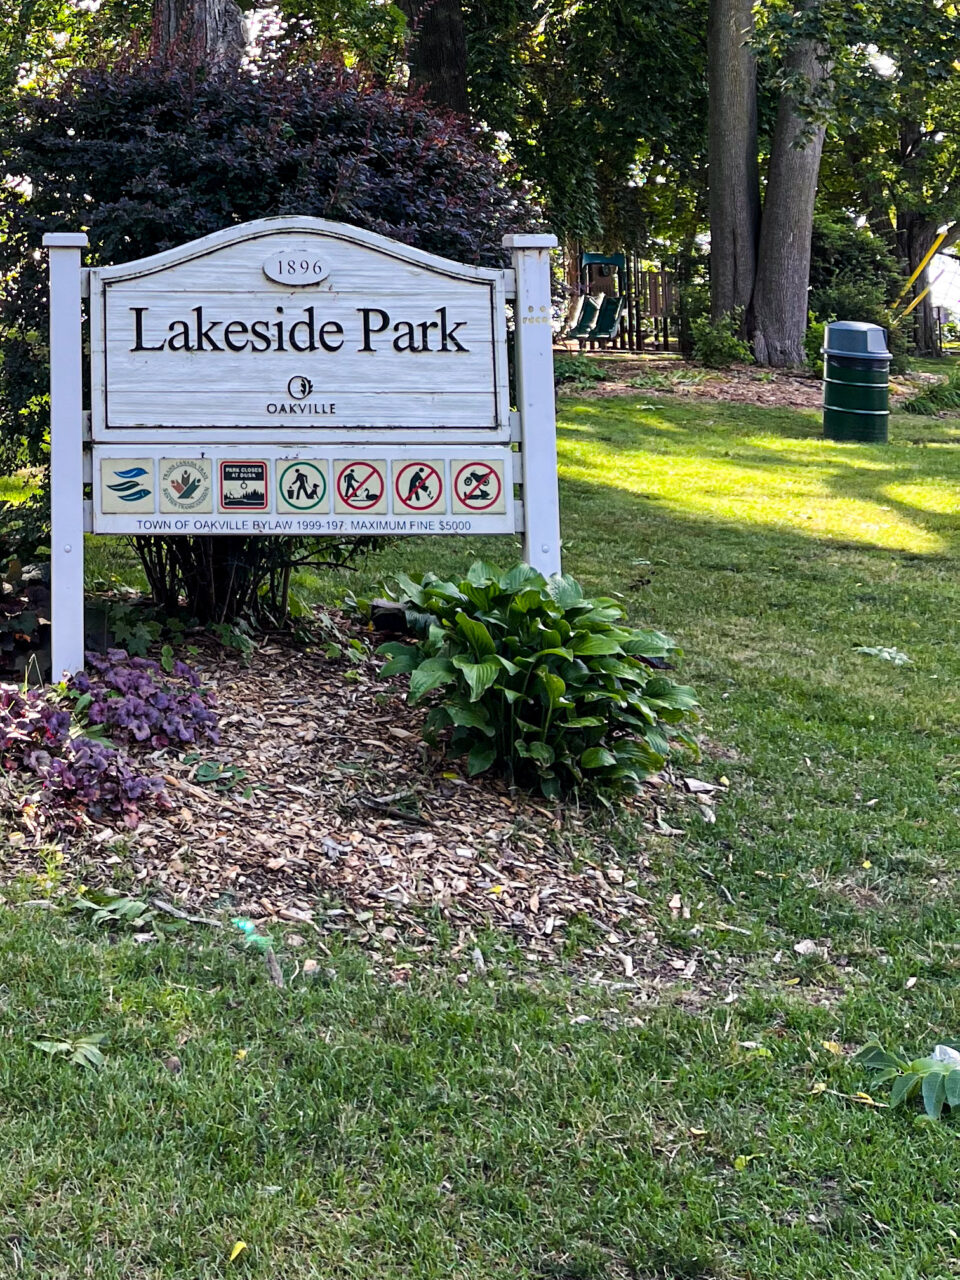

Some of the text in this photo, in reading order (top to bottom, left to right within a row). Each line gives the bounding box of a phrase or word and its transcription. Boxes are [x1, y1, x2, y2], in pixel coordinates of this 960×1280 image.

[278, 260, 322, 275] 1896
[129, 306, 470, 352] Lakeside Park
[266, 403, 337, 415] OAKVILLE
[136, 520, 171, 531] TOWN
[174, 520, 190, 531] OF
[193, 520, 249, 531] OAKVILLE
[252, 520, 293, 531] BYLAW
[350, 521, 407, 531] MAXIMUM
[410, 521, 435, 531] FINE
[439, 520, 472, 532] $5000
